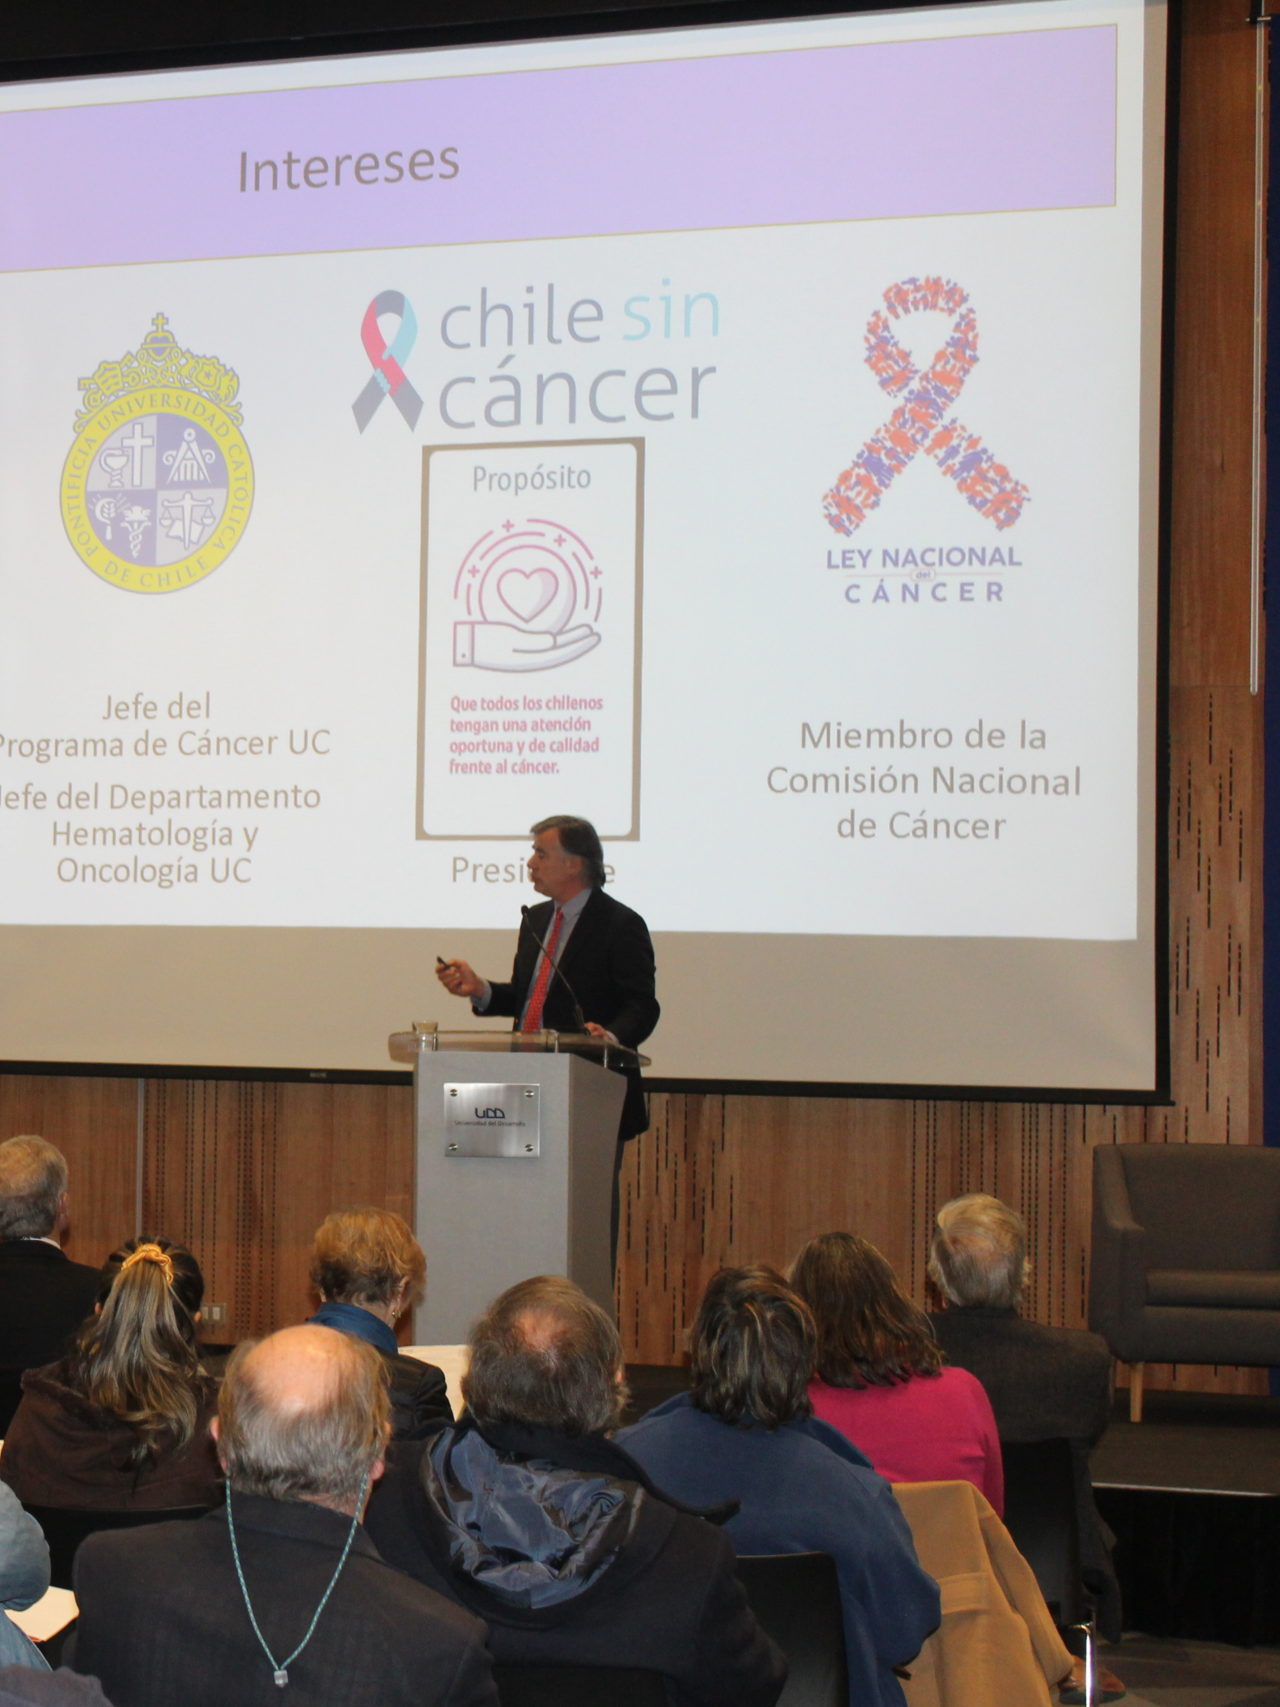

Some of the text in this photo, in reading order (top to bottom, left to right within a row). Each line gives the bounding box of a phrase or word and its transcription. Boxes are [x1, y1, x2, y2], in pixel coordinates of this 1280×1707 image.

[238, 147, 461, 193] Intereses
[440, 278, 720, 350] chile sin
[438, 354, 717, 430] cáncer
[97, 393, 231, 438] UNIVERSIDAD
[473, 463, 592, 497] Propósito
[66, 435, 99, 557] PONTIFICIA
[104, 560, 131, 582] DE
[139, 557, 209, 588] CHILE
[827, 546, 1023, 570] LEY NACIONAL
[844, 578, 1004, 604] CÁNCER
[102, 691, 211, 720] Jefe del
[450, 695, 603, 713] Que todos los chilenos
[449, 716, 592, 735] tengan una atención
[800, 718, 1047, 750] Miembro de la
[133, 729, 168, 756] de
[178, 729, 278, 756] Cáncer
[288, 729, 331, 755] UC
[449, 737, 600, 756] oportuna y de calidad
[449, 758, 560, 774] frente al cáncer.
[766, 765, 1081, 796] Comisión Nacional
[56, 782, 99, 809] del
[109, 784, 321, 815] Departamento
[52, 818, 259, 852] Hematología y
[837, 809, 1007, 840] de Cáncer
[56, 855, 252, 889] Oncología UC
[452, 856, 616, 884] Presie
